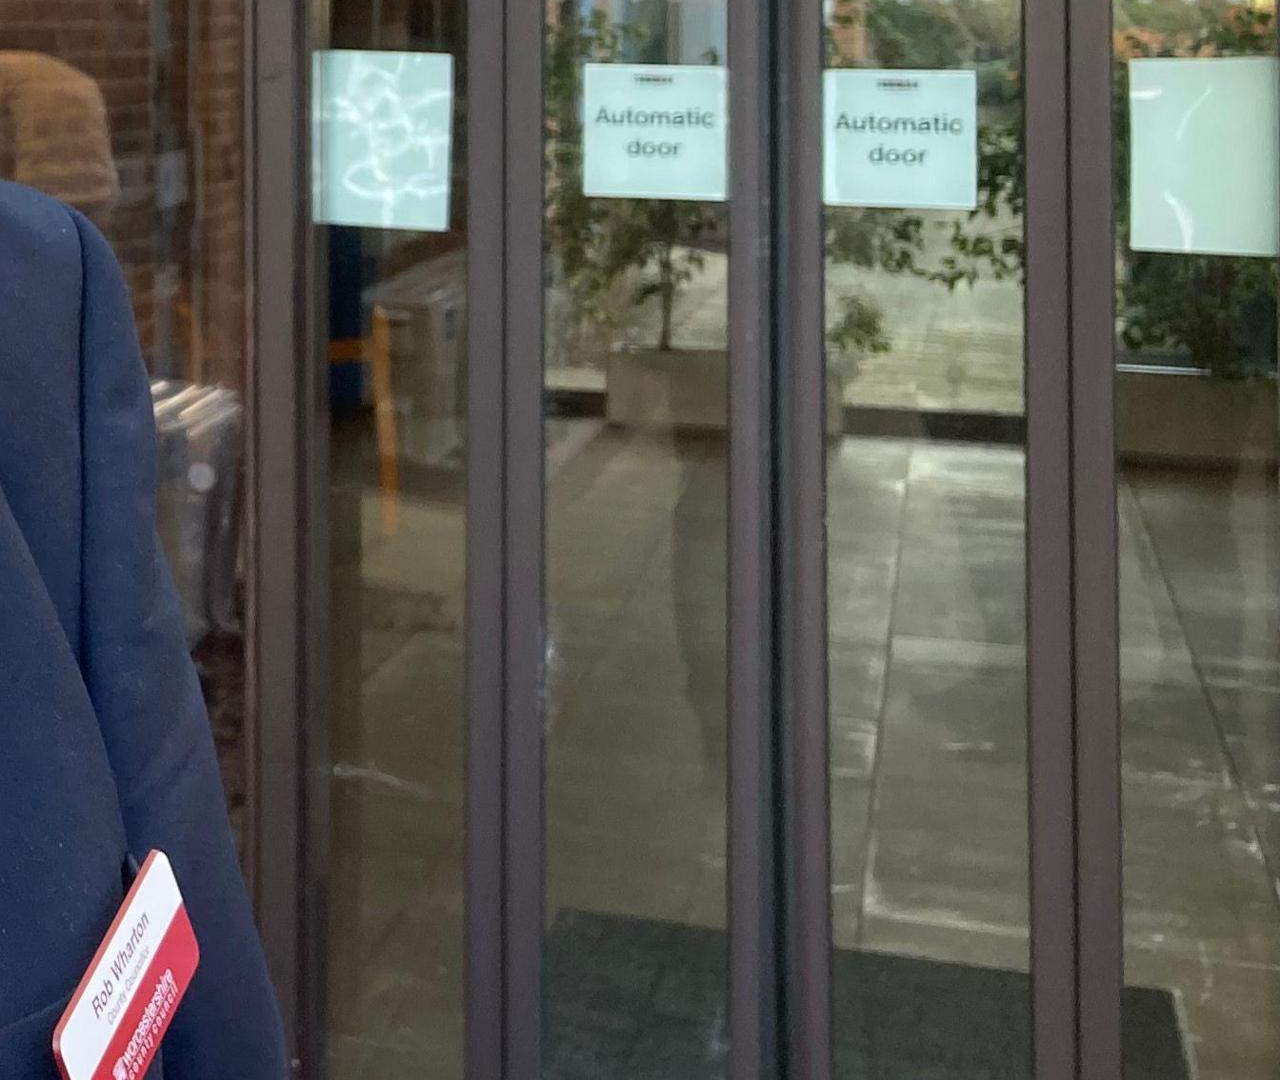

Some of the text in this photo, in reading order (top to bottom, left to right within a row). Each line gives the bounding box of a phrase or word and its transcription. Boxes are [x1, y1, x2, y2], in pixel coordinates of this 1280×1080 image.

[595, 104, 715, 128] Automatic
[835, 113, 963, 135] Automatic
[626, 137, 682, 159] door
[868, 143, 928, 166] door
[92, 912, 149, 1019] Rob Wharton
